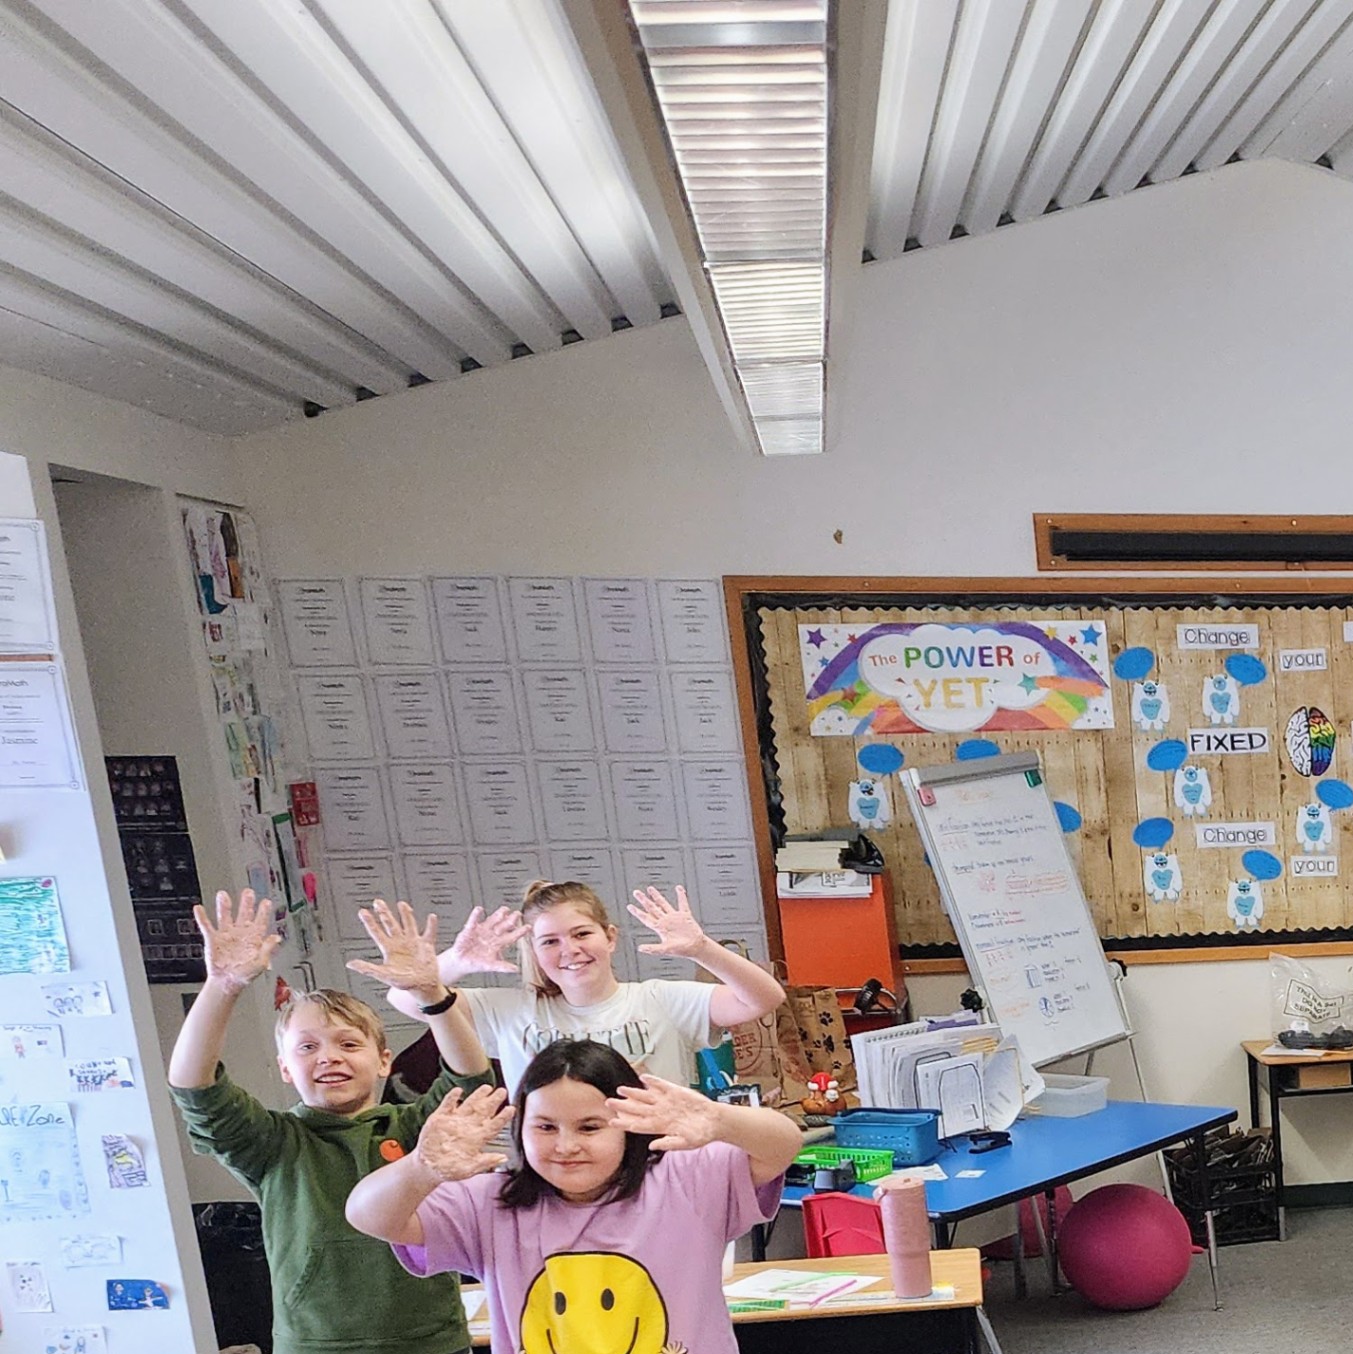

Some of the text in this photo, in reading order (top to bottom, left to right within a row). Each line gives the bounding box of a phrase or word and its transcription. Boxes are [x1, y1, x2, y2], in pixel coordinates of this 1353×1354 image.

[1184, 628, 1249, 646] Change
[868, 646, 1041, 668] The POWER of
[1282, 653, 1323, 669] your
[913, 677, 990, 709] YET
[1190, 733, 1266, 752] FIXED
[1204, 828, 1267, 843] Change
[1294, 860, 1334, 875] your
[27, 1105, 65, 1126] Zone
